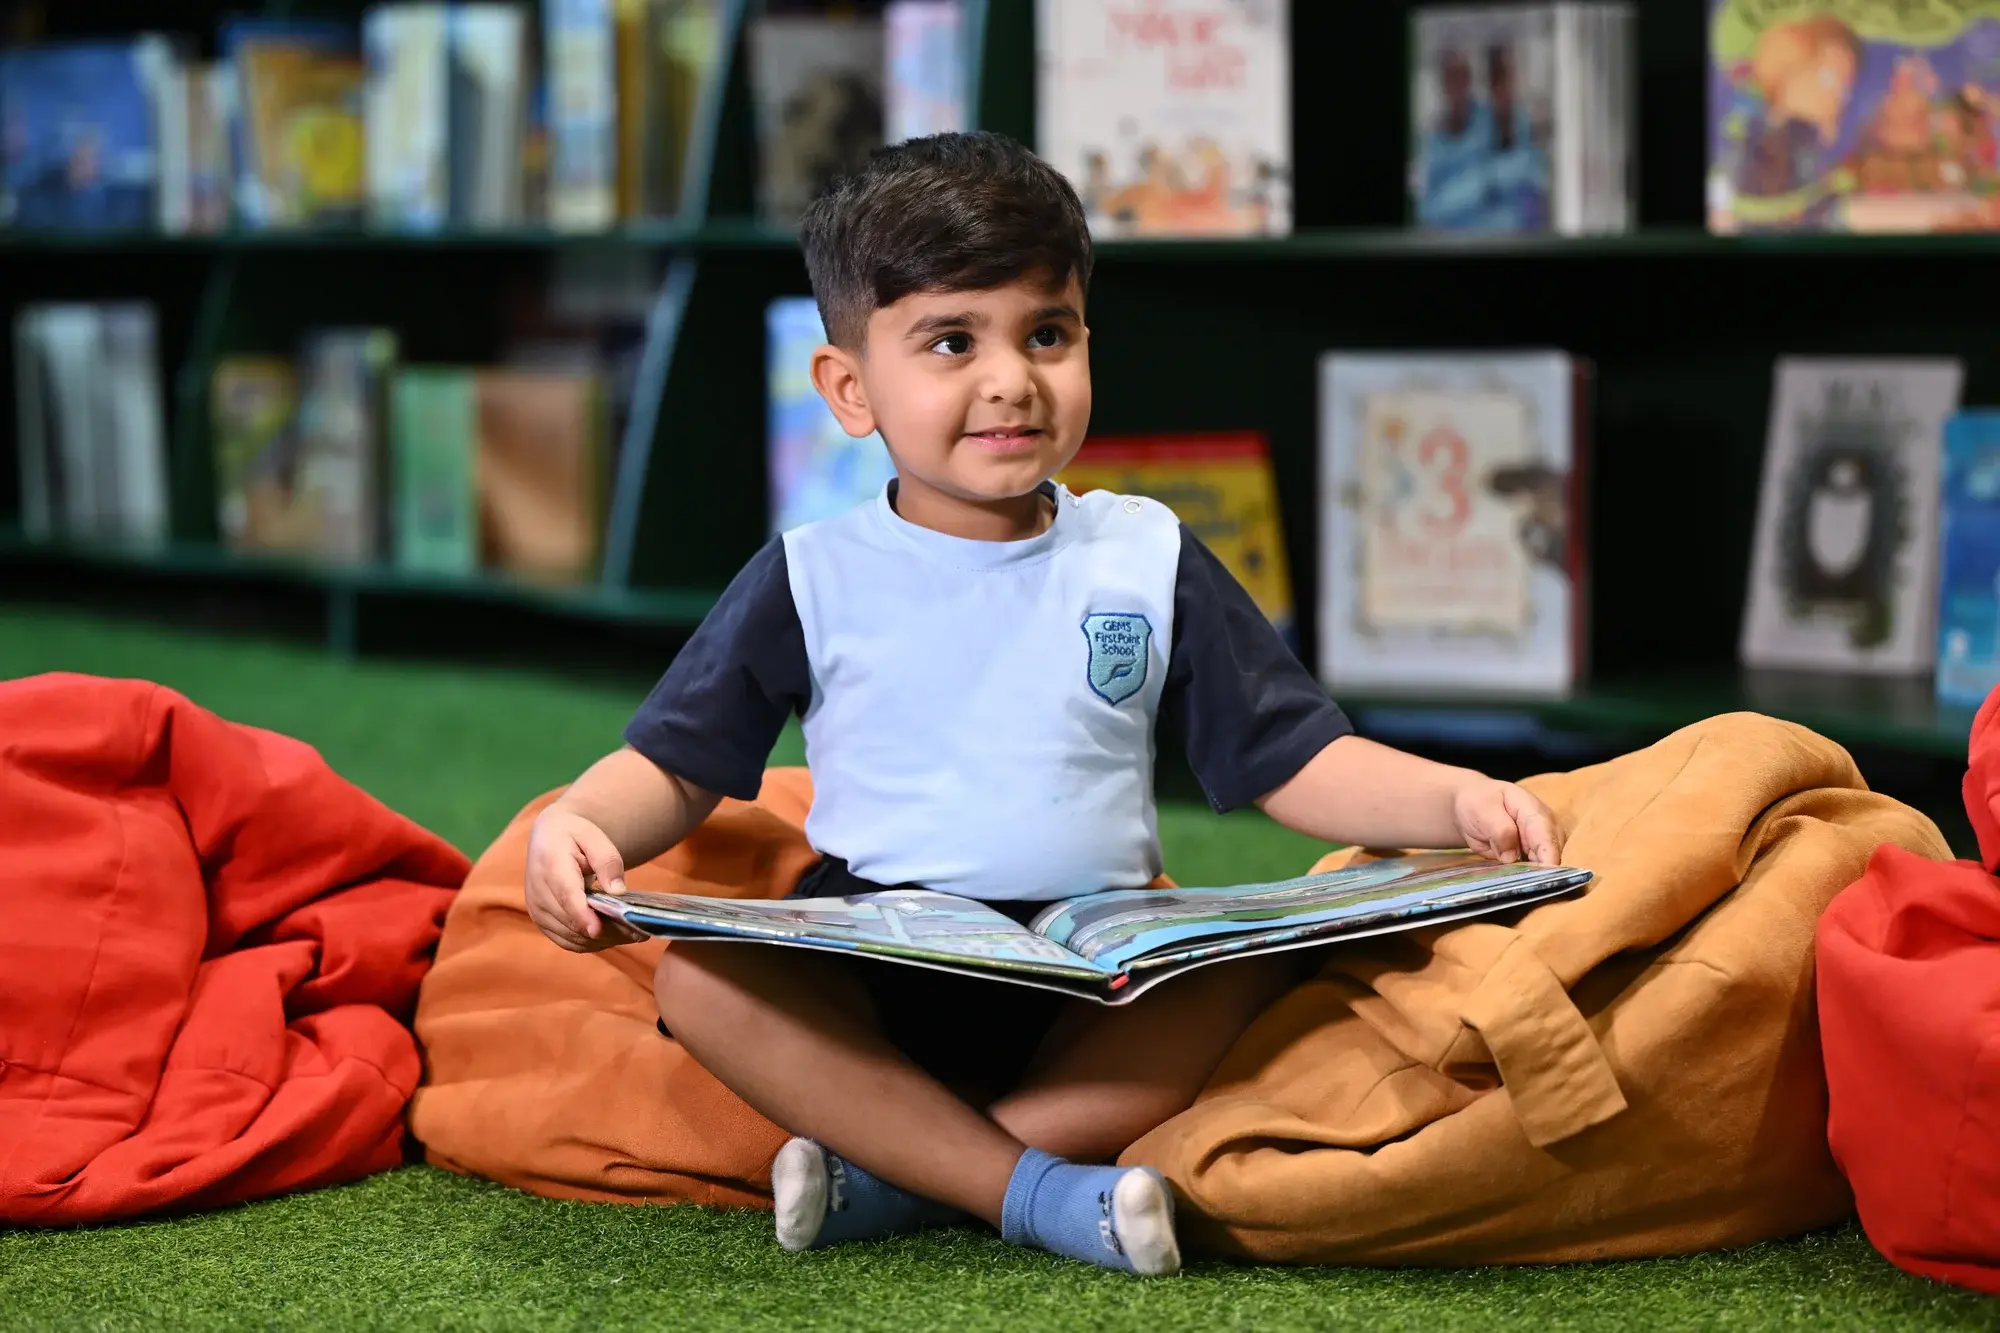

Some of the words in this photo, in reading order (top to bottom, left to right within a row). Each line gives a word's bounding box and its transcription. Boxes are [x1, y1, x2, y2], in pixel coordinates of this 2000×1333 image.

[1418, 426, 1471, 537] 3
[1103, 620, 1132, 632] GEMS
[1101, 643, 1136, 656] School
